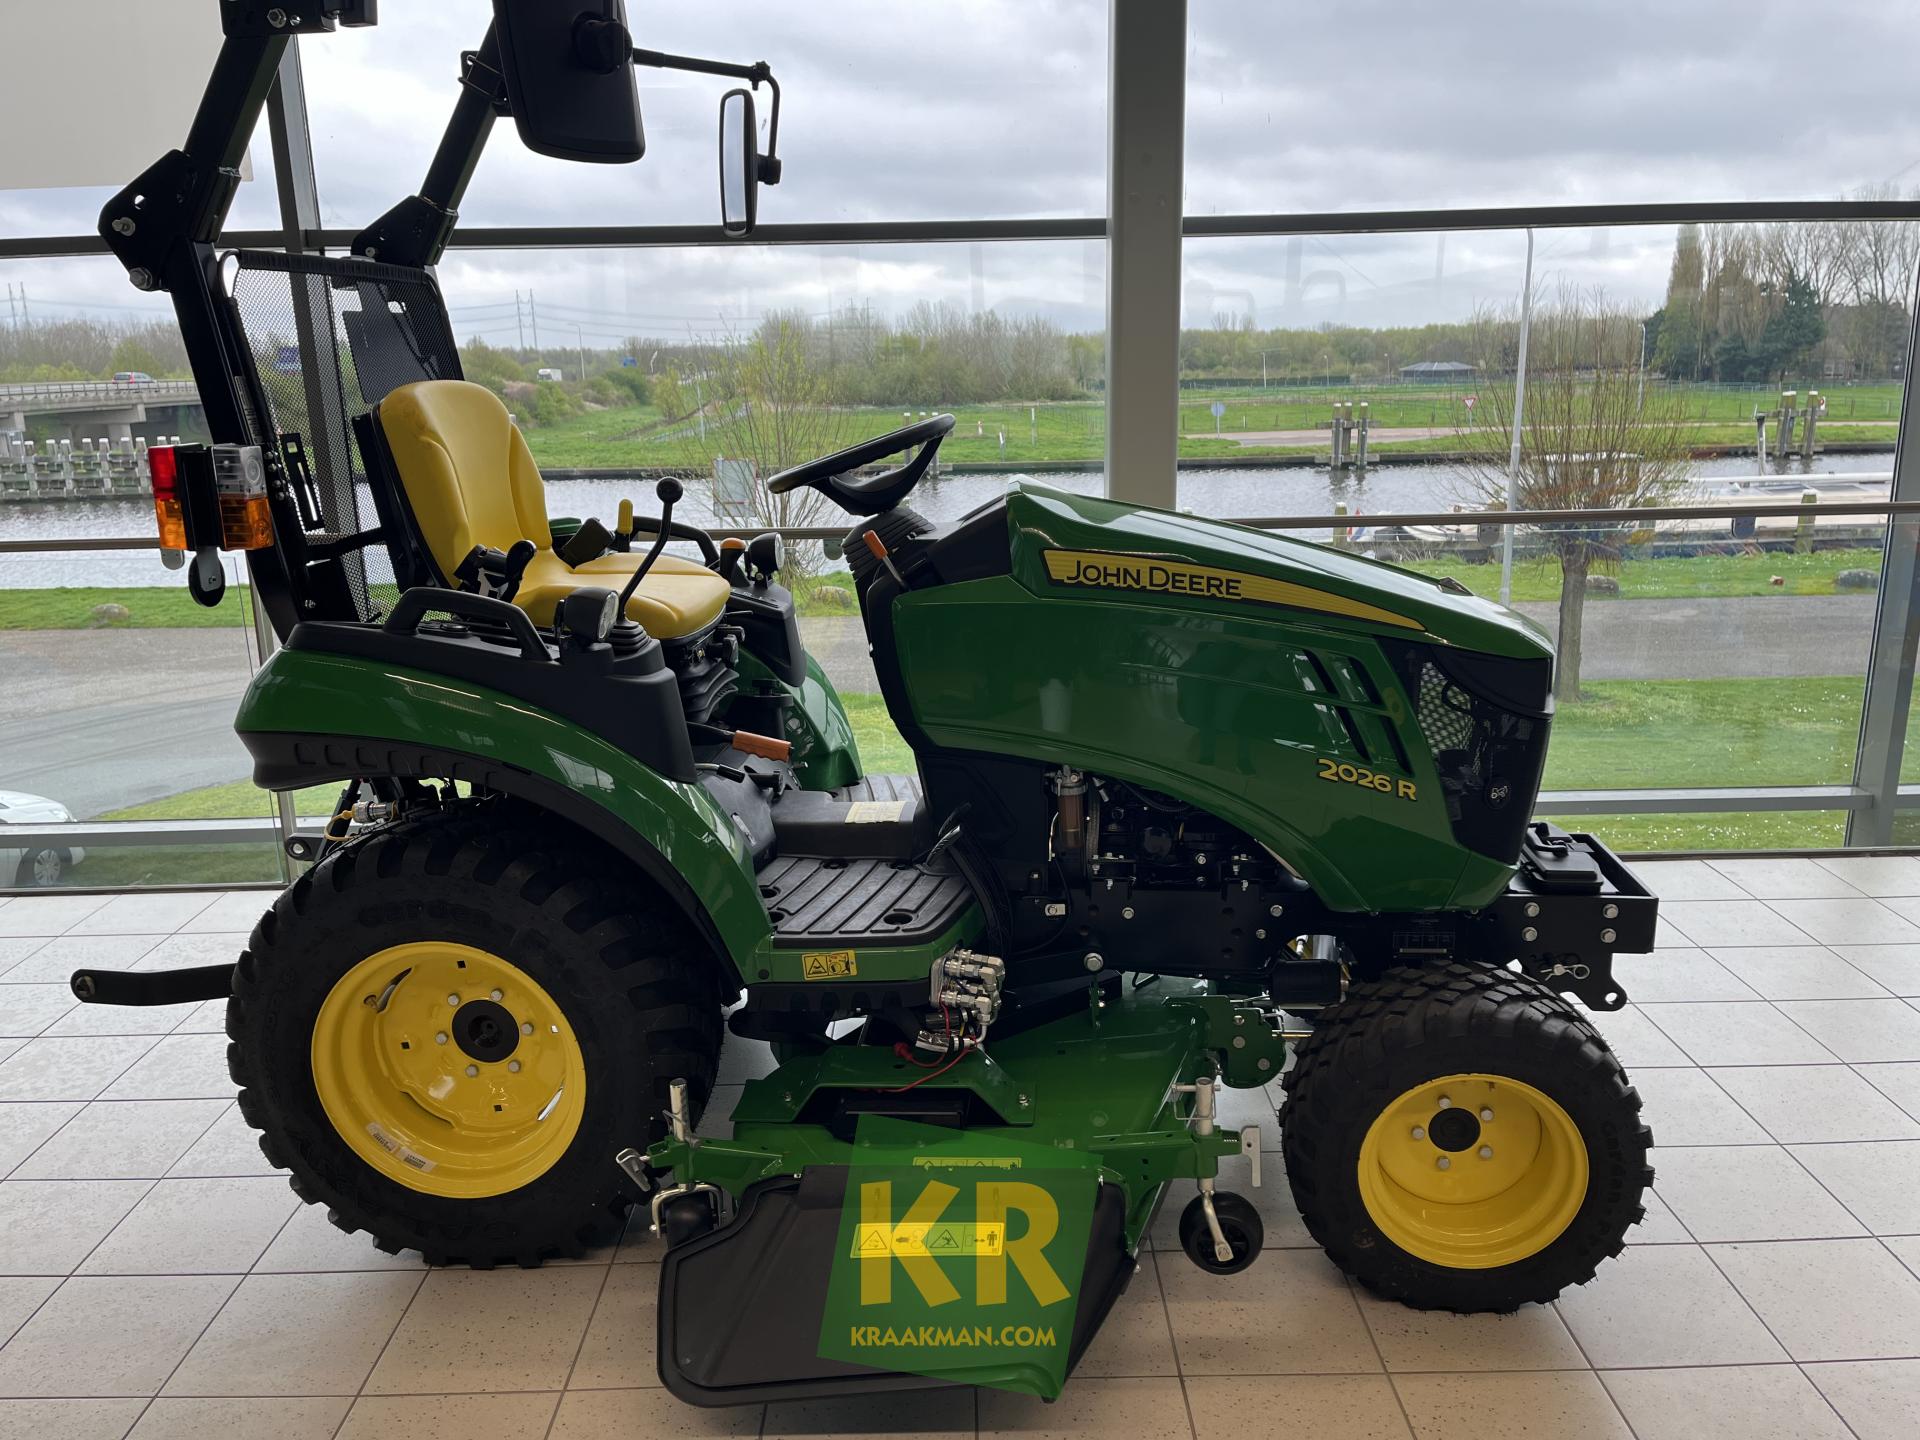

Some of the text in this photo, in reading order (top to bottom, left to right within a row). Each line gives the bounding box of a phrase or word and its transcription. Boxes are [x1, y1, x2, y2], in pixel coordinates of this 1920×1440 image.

[1066, 560, 1242, 597] JOHN DEERE
[1318, 758, 1417, 801] 2026 R
